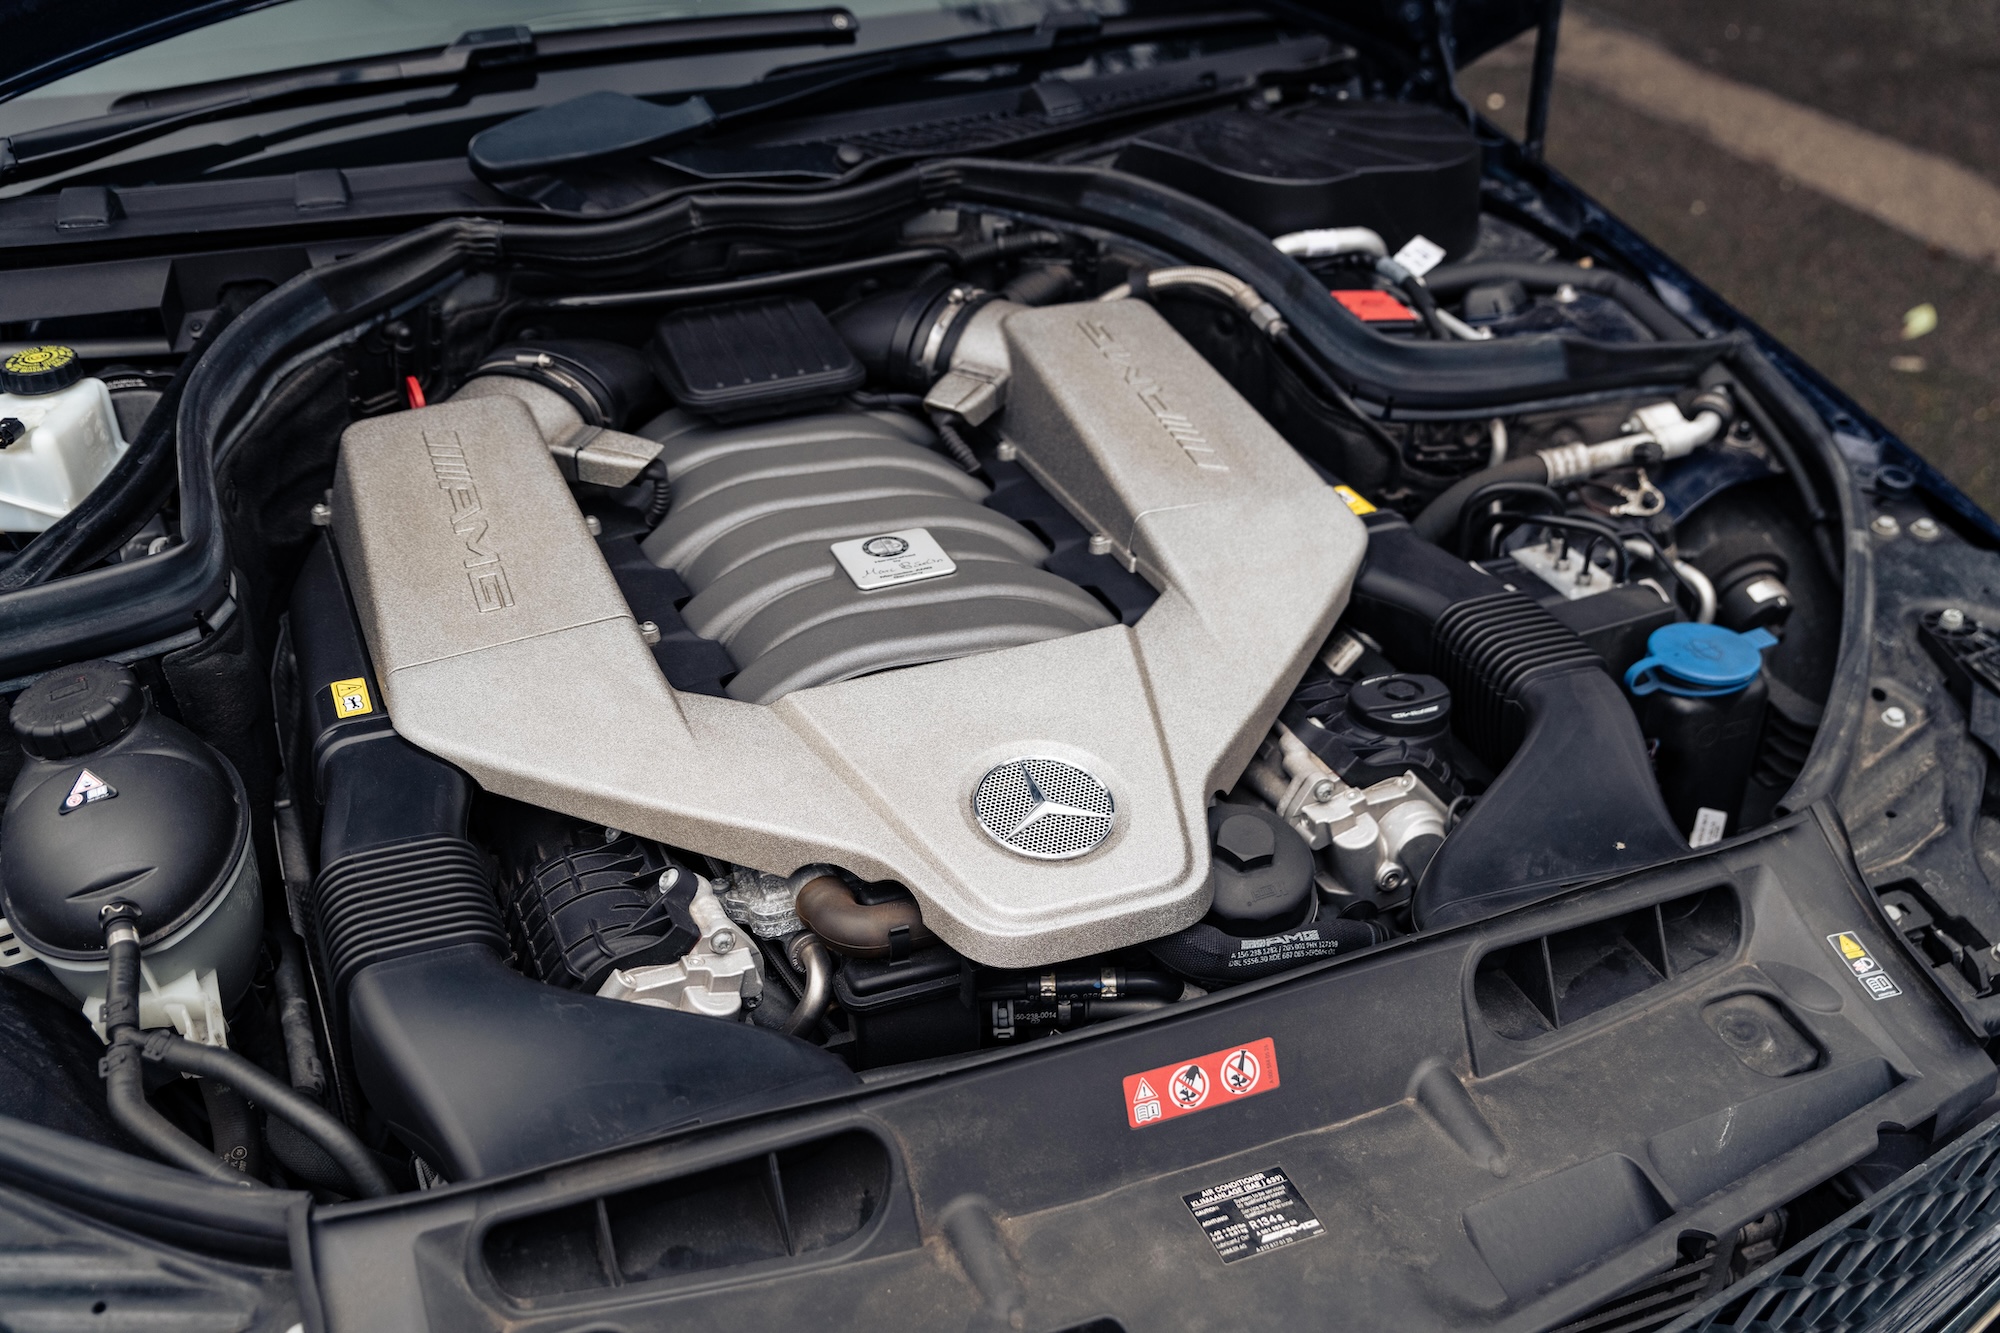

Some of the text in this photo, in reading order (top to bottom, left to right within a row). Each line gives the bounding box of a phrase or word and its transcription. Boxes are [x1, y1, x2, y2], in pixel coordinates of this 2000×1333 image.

[1014, 1011, 1057, 1020] 50-238-0014
[1190, 1186, 1244, 1208] KLIMAANLAGE
[1266, 1174, 1285, 1185] 639)
[1201, 1172, 1266, 1198] AIR CONDITIONER
[1248, 1213, 1285, 1231] R134a
